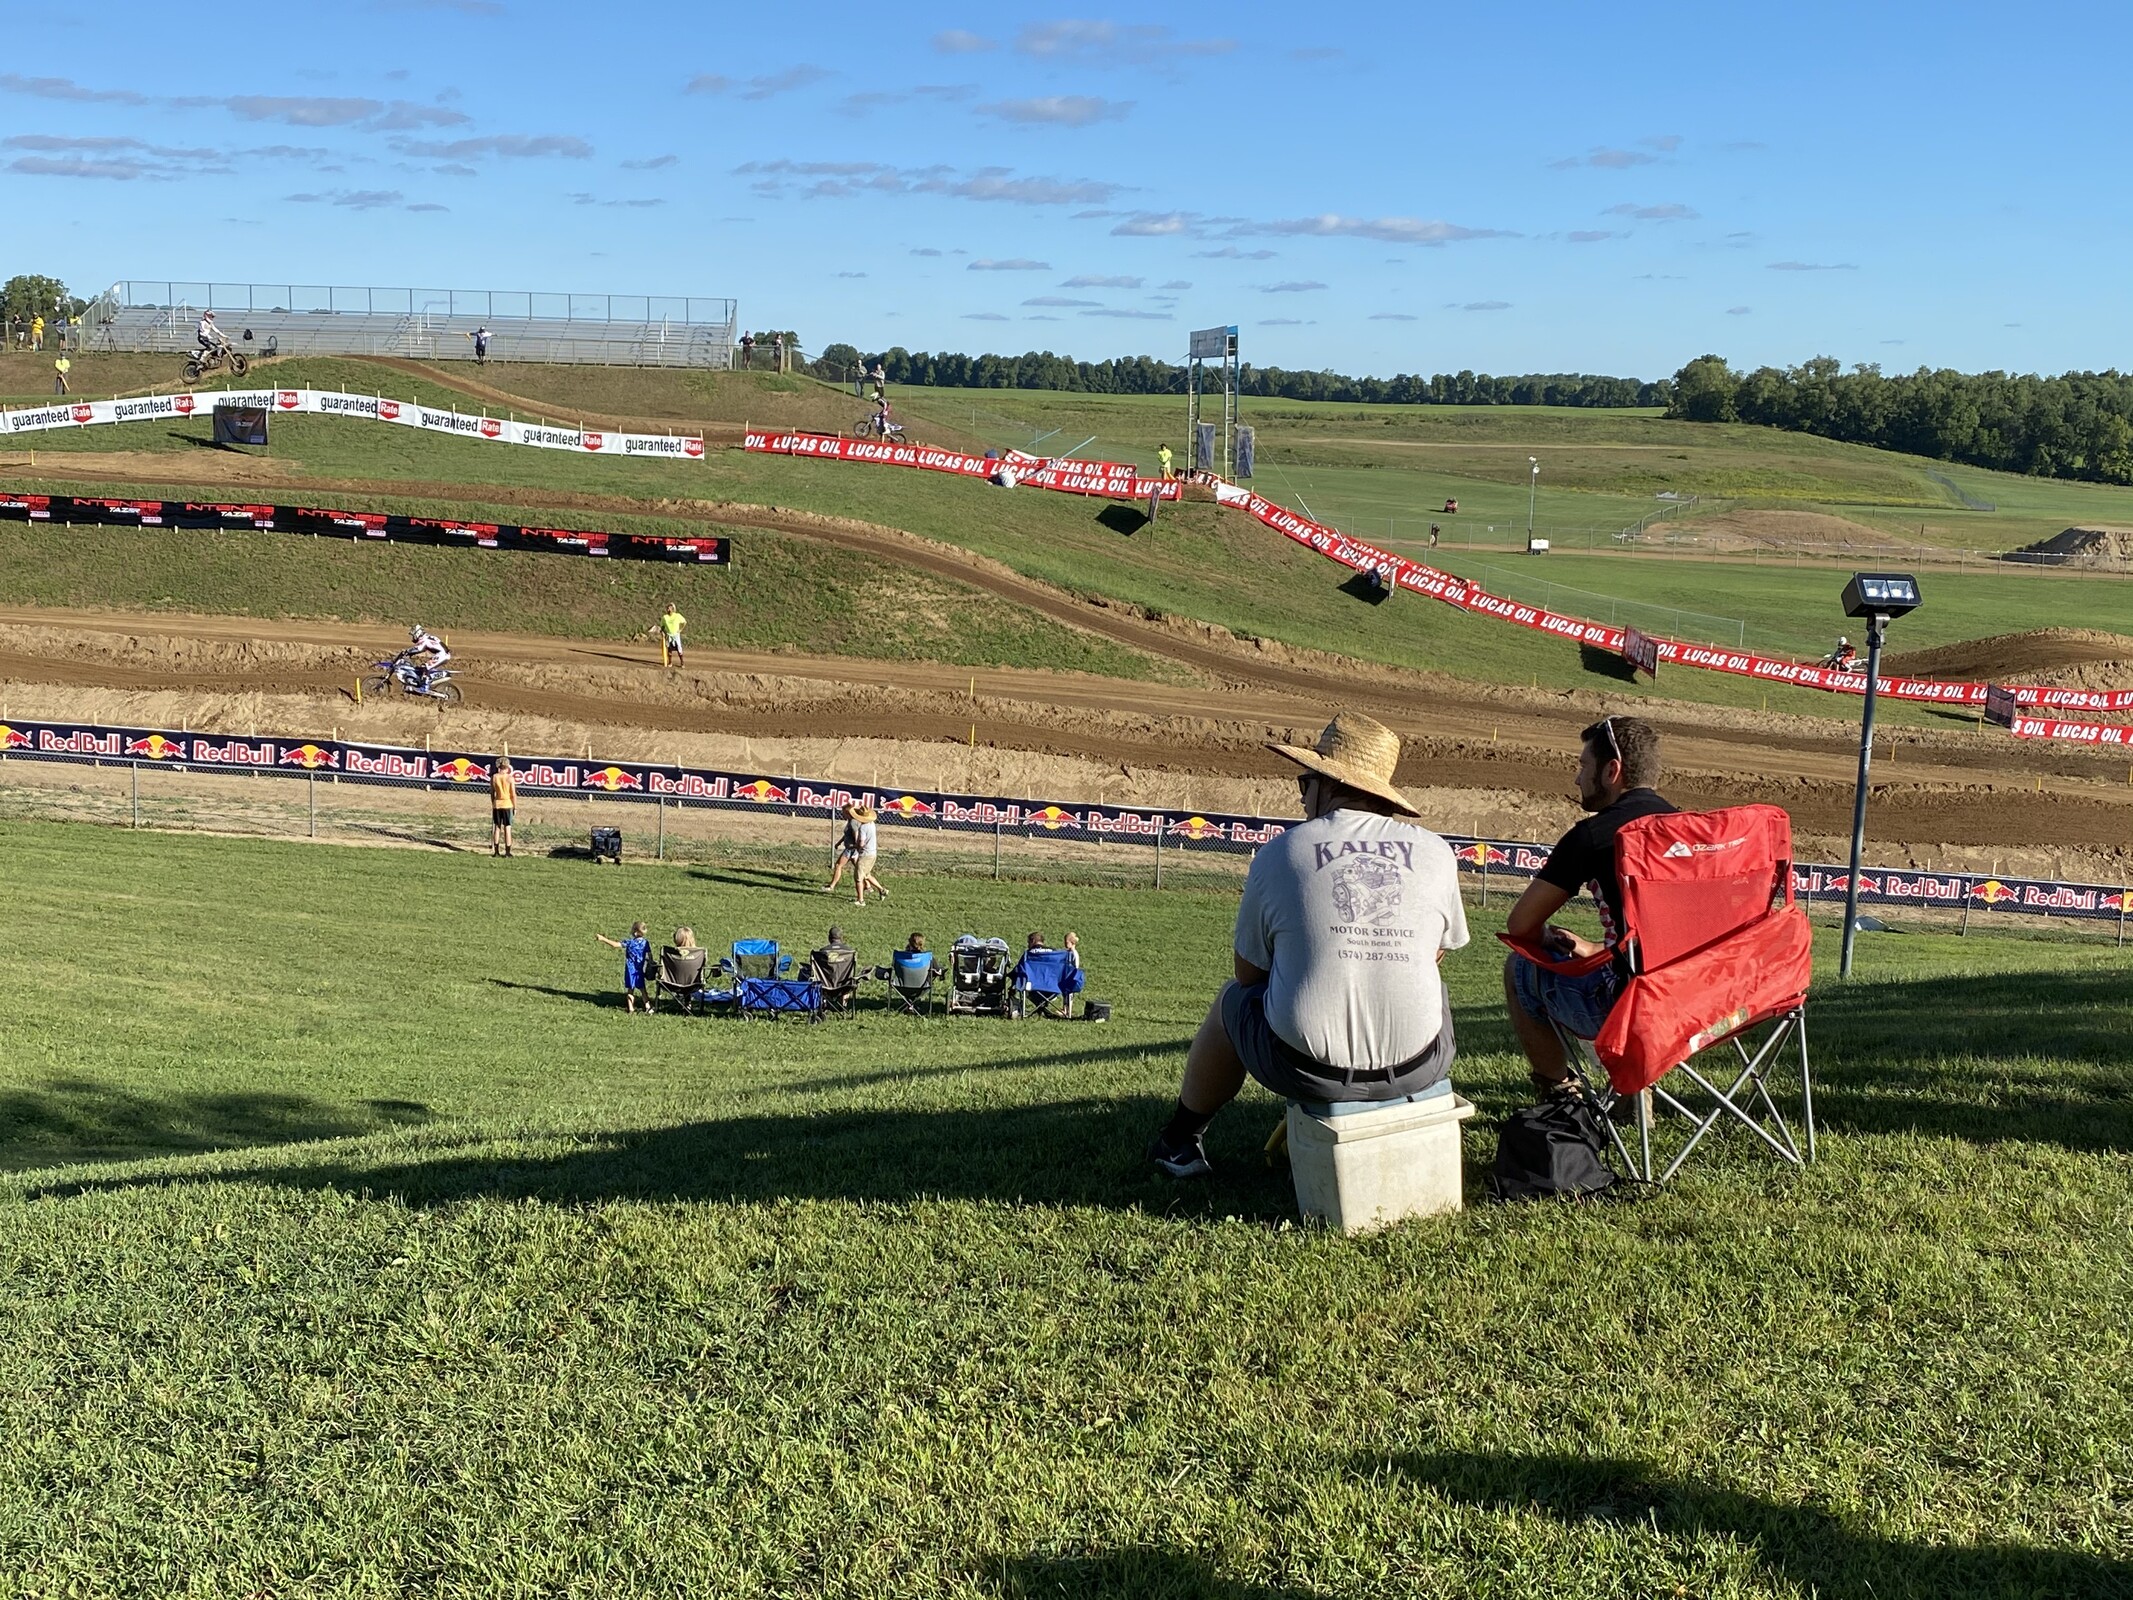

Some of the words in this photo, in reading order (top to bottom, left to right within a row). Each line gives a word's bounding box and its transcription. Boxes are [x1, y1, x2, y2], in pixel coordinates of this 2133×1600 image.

[279, 393, 297, 403] Rate
[321, 396, 377, 413] guaranteed
[380, 402, 398, 414] Rate
[115, 398, 172, 419] guaranteed
[12, 407, 69, 430] guaranteed
[72, 408, 91, 418] Rate
[422, 411, 478, 432] guaranteed
[482, 421, 500, 433] Rate
[523, 426, 580, 446] guaranteed
[584, 435, 601, 446] Rate
[745, 435, 766, 448] OIL
[772, 436, 817, 451] LUCAS
[819, 440, 840, 454] OIL
[625, 438, 681, 453] guaranteed
[685, 441, 703, 452] Rate
[847, 442, 891, 460] LUCAS
[894, 447, 916, 462] OIL
[918, 450, 960, 469] LUCAS
[963, 459, 985, 473] OIL
[1085, 464, 1103, 475] OIL
[1036, 470, 1057, 484] OIL
[1062, 473, 1107, 491] LUCAS
[1108, 478, 1129, 492] OIL
[1250, 499, 1269, 516] OIL
[1270, 511, 1312, 539] LUCAS
[1312, 533, 1332, 550] OIL
[1401, 571, 1445, 594] LUCAS
[1445, 586, 1467, 602] OIL
[1470, 594, 1515, 617] LUCAS
[1514, 608, 1537, 624] OIL
[1541, 615, 1584, 638] LUCAS
[1584, 628, 1606, 643] OIL
[1658, 643, 1678, 658] OIL
[1682, 648, 1726, 667] LUCAS
[1728, 656, 1751, 671] OIL
[1753, 663, 1798, 679] LUCAS
[1799, 669, 1820, 683] OIL
[1825, 674, 1867, 690] LUCAS
[1897, 682, 1942, 697] LUCAS
[1943, 686, 1964, 699] OIL
[2017, 689, 2039, 703] OIL
[2043, 692, 2089, 706] LUCAS
[2089, 696, 2110, 708] OIL
[2024, 721, 2046, 736] OIL
[2052, 723, 2100, 740] LUCAS
[2100, 728, 2122, 743] OIL
[1313, 841, 1415, 873] KALEY
[1329, 926, 1369, 936] MOTOR
[1372, 928, 1415, 938] SERVICE
[1347, 938, 1369, 946] South
[1338, 949, 1363, 961] (574)
